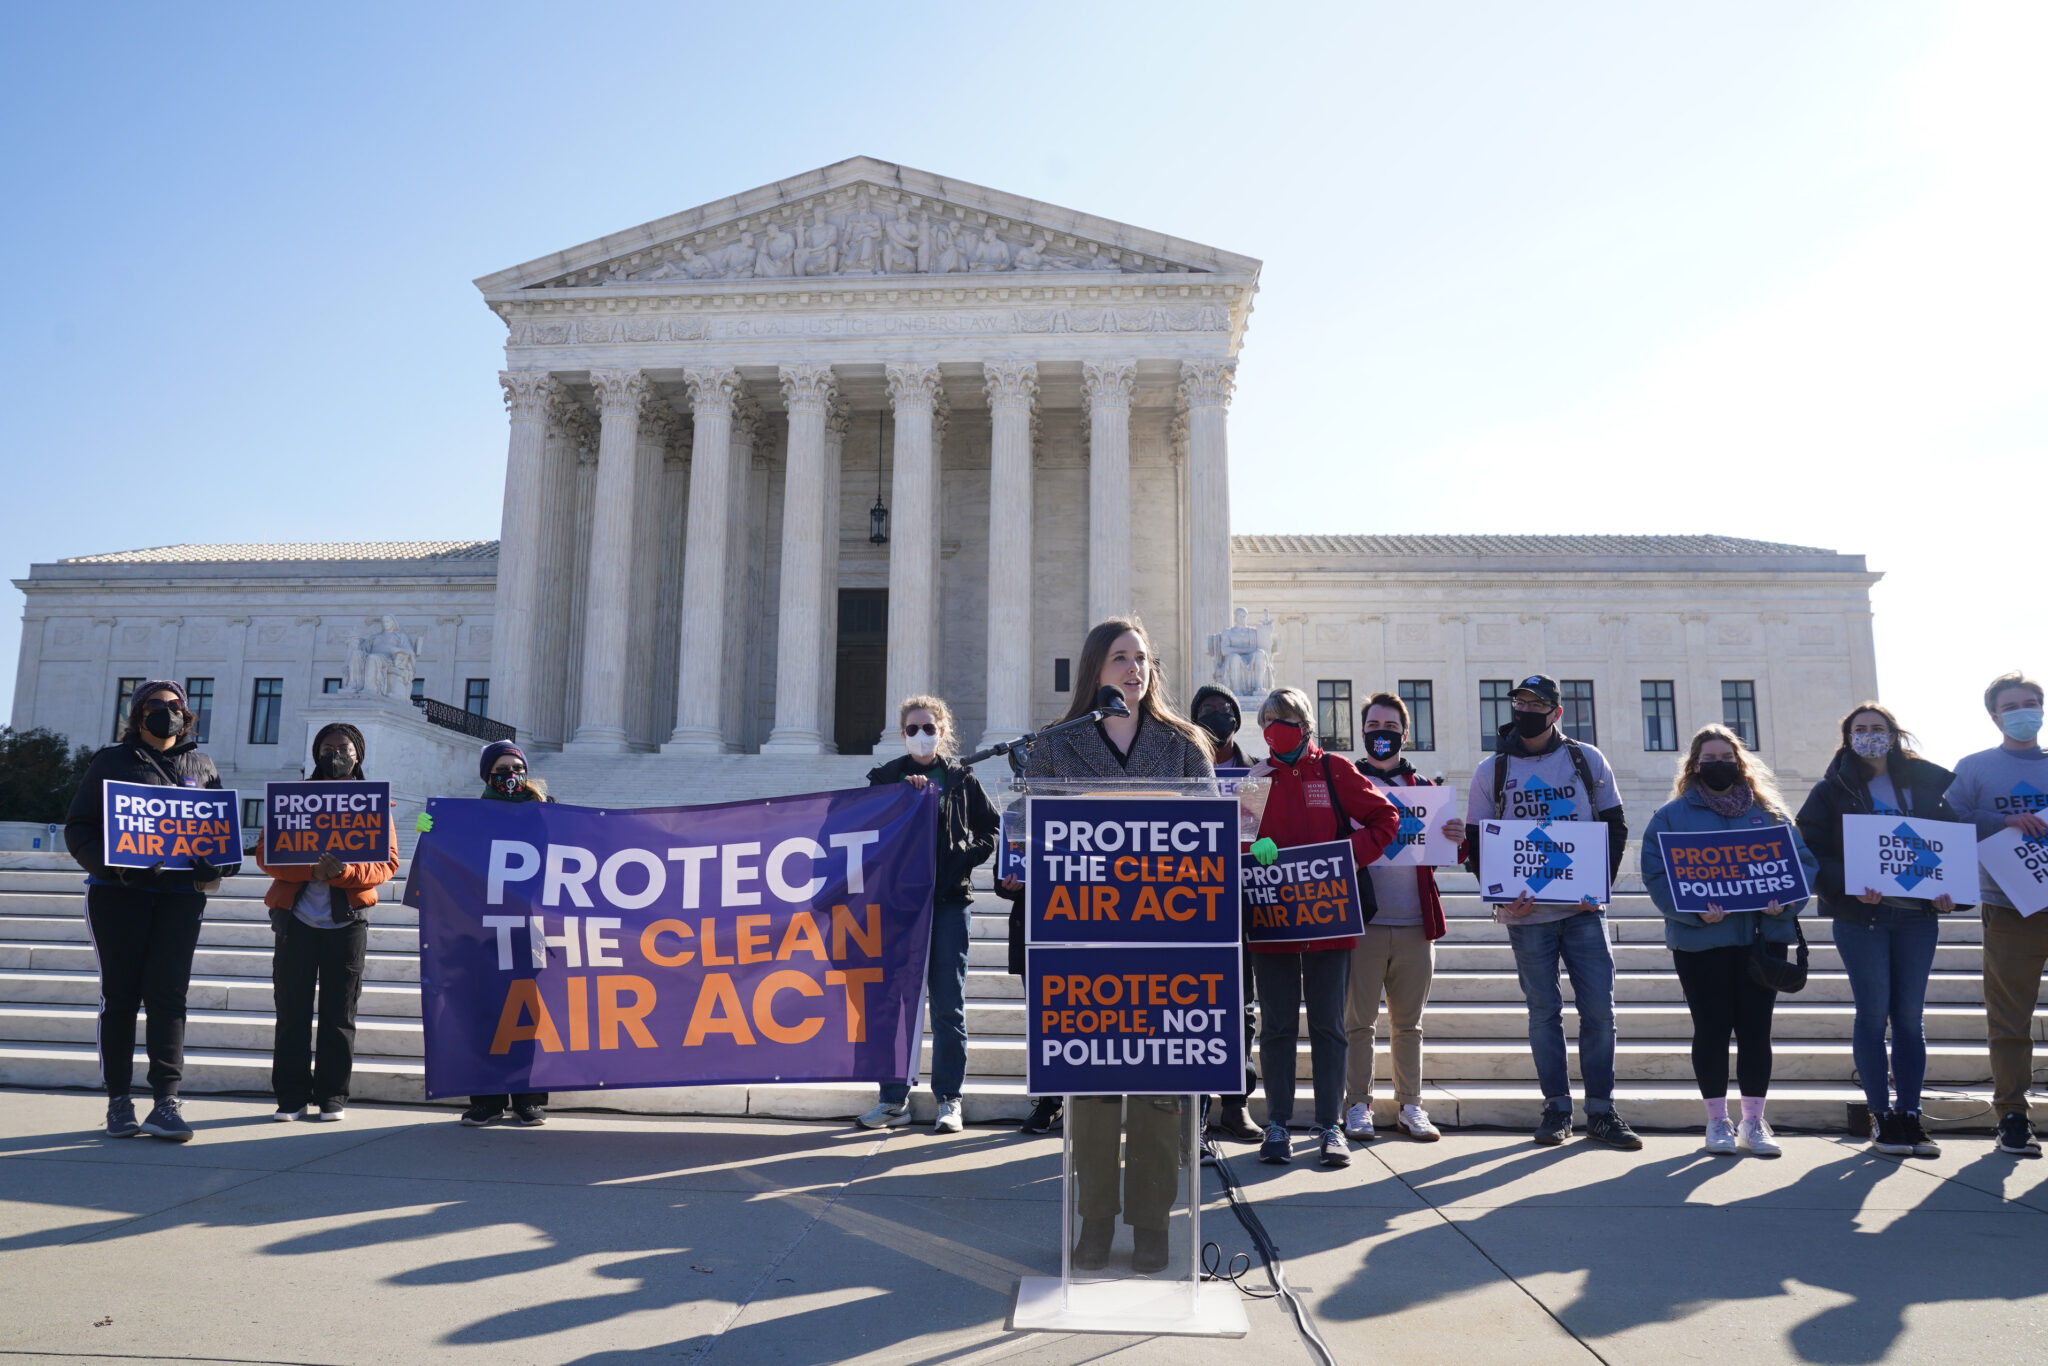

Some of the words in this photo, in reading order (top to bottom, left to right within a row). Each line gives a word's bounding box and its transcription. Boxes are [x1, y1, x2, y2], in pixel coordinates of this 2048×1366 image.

[801, 317, 873, 334] JUSTICE
[884, 315, 952, 333] UNDER
[959, 315, 998, 331] LAW
[274, 793, 381, 813] PROTECT
[1513, 785, 1576, 804] DEFEND
[1994, 794, 2048, 810] DEFE
[115, 794, 228, 819] PROTECT
[1397, 805, 1427, 818] END
[1513, 803, 1550, 818] OUR
[115, 814, 155, 833] THE
[159, 819, 230, 835] CLEAN
[273, 814, 311, 830] THE
[315, 813, 381, 829] CLEAN
[115, 832, 165, 856] AIR
[171, 835, 231, 857] ACT
[274, 831, 319, 852] AIR
[325, 830, 381, 851] ACT
[1044, 820, 1225, 852] PROTECT
[1396, 833, 1426, 845] URE
[1513, 839, 1575, 854] DEFEND
[1879, 835, 1944, 853] DEFEND
[1513, 852, 1549, 865] OUR
[1670, 841, 1782, 865] PROTECT
[1879, 849, 1918, 863] OUR
[487, 829, 880, 911] PROTECT
[1043, 855, 1107, 882] THE
[1113, 855, 1225, 883] CLEAN
[1241, 856, 1344, 887] PROTECT
[1513, 866, 1574, 881] FUTURE
[1675, 865, 1746, 880] PEOPLE,
[1748, 859, 1789, 877] NOT
[1880, 862, 1944, 881] FUTURE
[1243, 886, 1279, 905] THE
[1280, 878, 1348, 903] CLEAN
[1678, 874, 1796, 897] POLLUTERS
[1043, 885, 1120, 921] AIR
[1130, 885, 1225, 921] ACT
[1252, 905, 1290, 928] AIR
[1295, 898, 1349, 926] ACT
[482, 914, 624, 971] THE
[639, 904, 882, 968] CLEAN
[1042, 973, 1224, 1006] PROTECT
[488, 974, 659, 1055] AIR
[682, 967, 884, 1047] ACT
[1042, 1009, 1156, 1037] PEOPLE,
[1163, 1008, 1227, 1033] NOT
[1042, 1038, 1228, 1066] POLLUTERS
